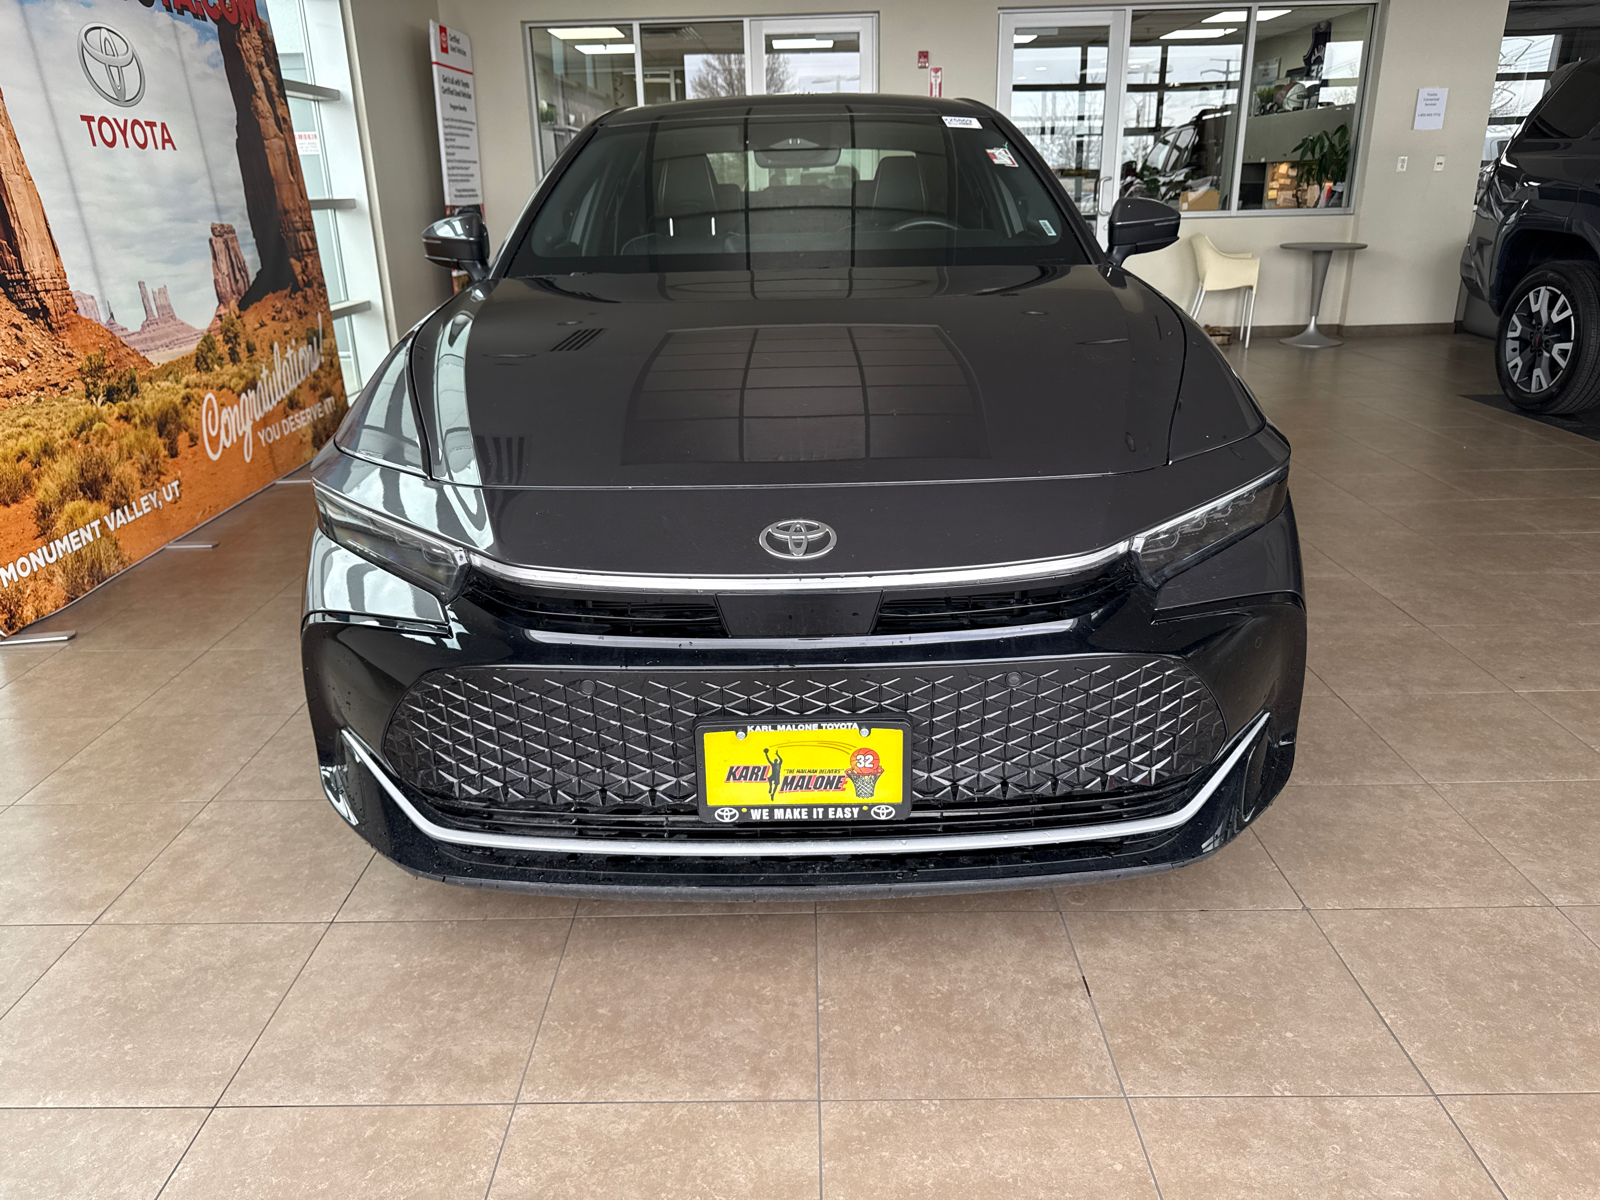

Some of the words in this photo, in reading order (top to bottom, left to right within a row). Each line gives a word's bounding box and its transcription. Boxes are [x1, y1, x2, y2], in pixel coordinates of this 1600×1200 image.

[80, 114, 178, 151] TOYOTA
[202, 312, 325, 463] Congratulations!
[257, 418, 281, 447] YOU
[280, 401, 324, 436] DESERVE
[323, 396, 337, 416] IT!
[0, 519, 102, 588] MONUMENT
[103, 490, 163, 532] VALLEY,
[162, 479, 181, 503] UT
[777, 723, 819, 731] MALONE
[821, 722, 859, 730] TOYOTA
[856, 754, 874, 768] 32
[725, 765, 770, 783] KARL
[779, 775, 848, 793] MALONE
[750, 808, 770, 820] WE
[773, 808, 809, 820] MAKE
[813, 807, 825, 819] IT
[828, 807, 860, 819] EASY
